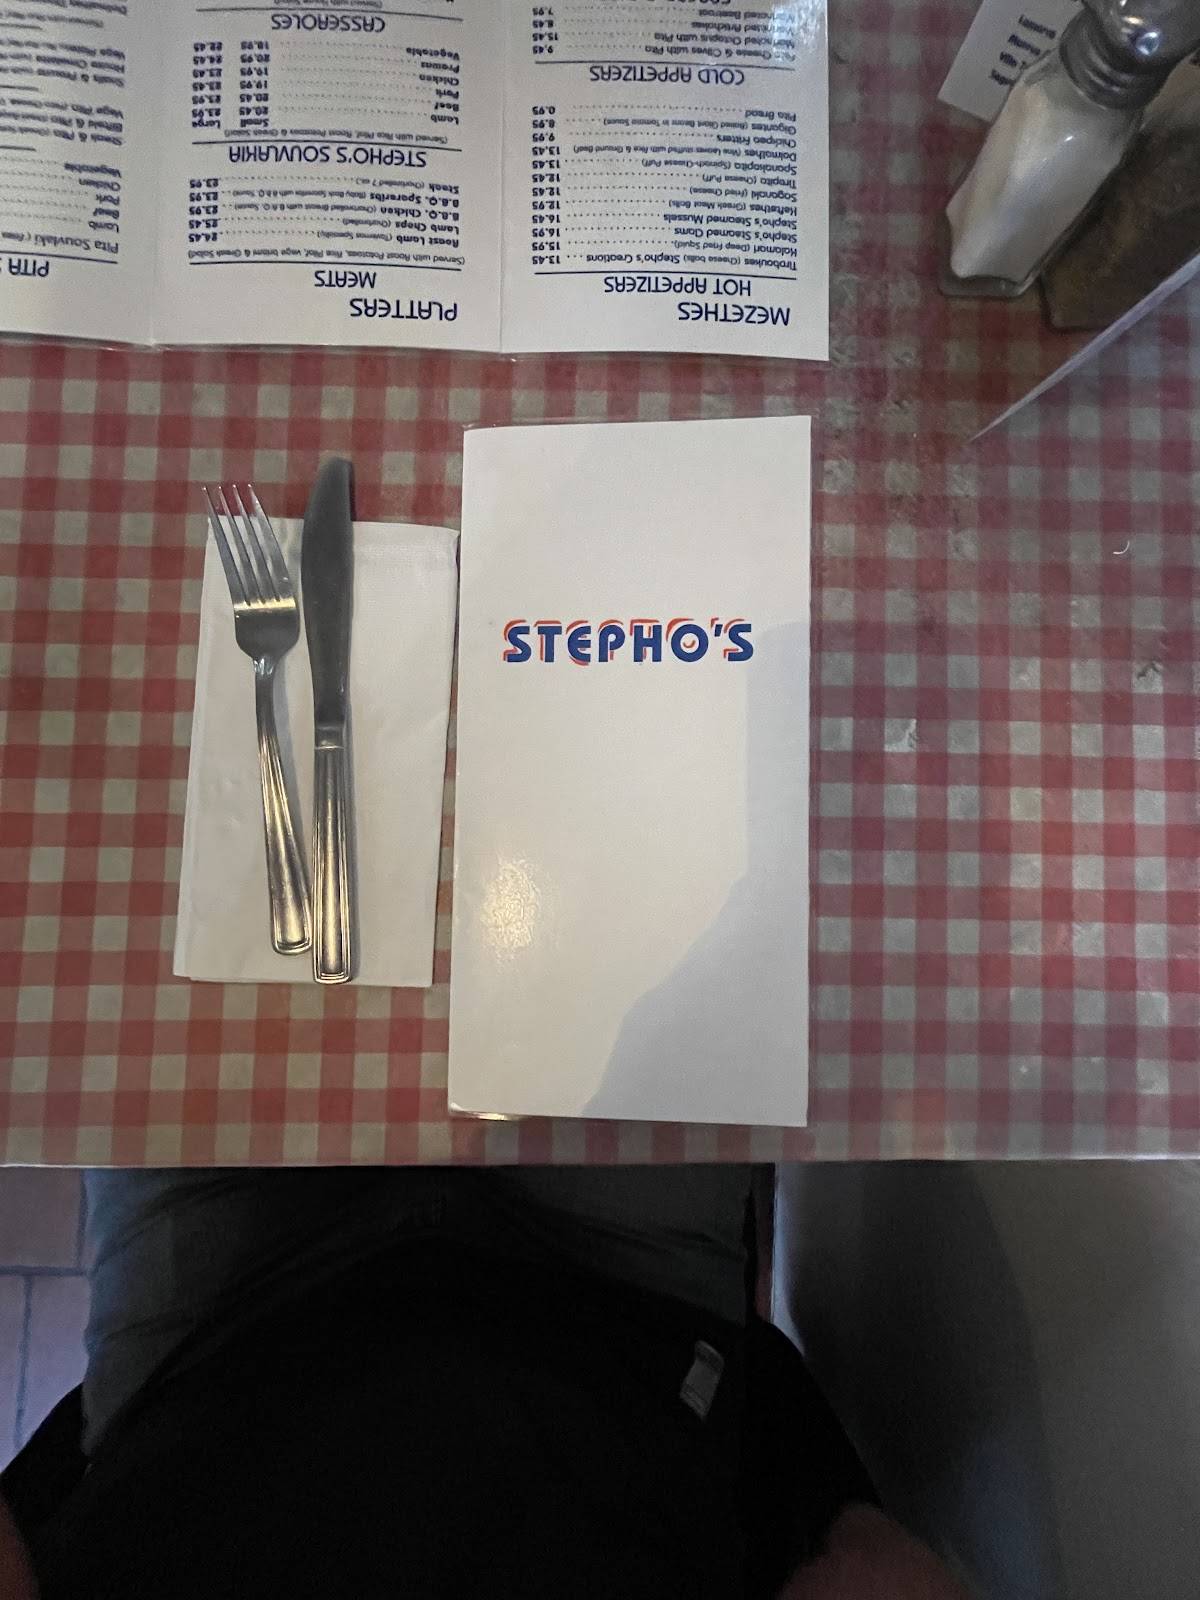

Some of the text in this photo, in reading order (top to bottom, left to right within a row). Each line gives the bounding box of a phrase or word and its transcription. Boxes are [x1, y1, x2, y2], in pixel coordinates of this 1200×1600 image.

[272, 14, 385, 33] CASSEROLES
[654, 32, 673, 42] Pita
[676, 34, 697, 42] with
[406, 48, 460, 60] Vegetable
[644, 45, 664, 55] Pita
[667, 46, 688, 55] with
[421, 62, 459, 74] Prawns
[419, 74, 459, 86] Chicken
[590, 66, 744, 86] COLD APPETIZERS
[436, 89, 459, 98] Pork
[434, 102, 460, 112] Beef
[430, 114, 459, 125] Lamb
[532, 106, 796, 122] Pita Bread 0.95
[192, 118, 269, 128] Small Large
[752, 122, 796, 135] Gigantes
[532, 132, 796, 148] Chickpea Fritters 9.95
[228, 145, 426, 168] STEPHO'S SOUVLAKIA
[532, 146, 560, 156] 13.45
[744, 150, 796, 162] Dolmathes
[532, 160, 560, 169] 13.45
[734, 162, 797, 176] Spanakopita
[428, 183, 459, 194] Steak
[760, 176, 796, 189] Tiropita
[96, 194, 120, 206] Pork
[370, 192, 422, 204] Spareribs
[752, 190, 797, 202] Saganaki
[532, 200, 560, 210] 12.95
[380, 206, 421, 218] Chicken
[88, 221, 120, 234] Lamb
[395, 220, 426, 232] Chops
[532, 214, 797, 230] Stepho's Steamed Mussels 16.45
[430, 224, 460, 235] Lamb
[532, 228, 797, 243] Stepho's Steamed Clams 16.95
[34, 234, 91, 250] Souvlaki
[396, 235, 425, 246] Lamb
[428, 237, 459, 248] Roast
[532, 241, 560, 250] 15.95
[94, 240, 119, 254] Pita
[726, 242, 750, 252] (Deep
[754, 246, 797, 256] Kalamari
[532, 254, 560, 264] 13.45
[587, 254, 632, 263] Creations
[636, 252, 680, 263] Stepho's
[8, 258, 50, 278] PITA
[314, 270, 376, 288] MEATS
[603, 276, 751, 296] HOT APPETIZERS
[349, 298, 458, 322] PLATTERS
[678, 302, 790, 326] MEZETHES
[503, 617, 755, 666] STEPHO'S
